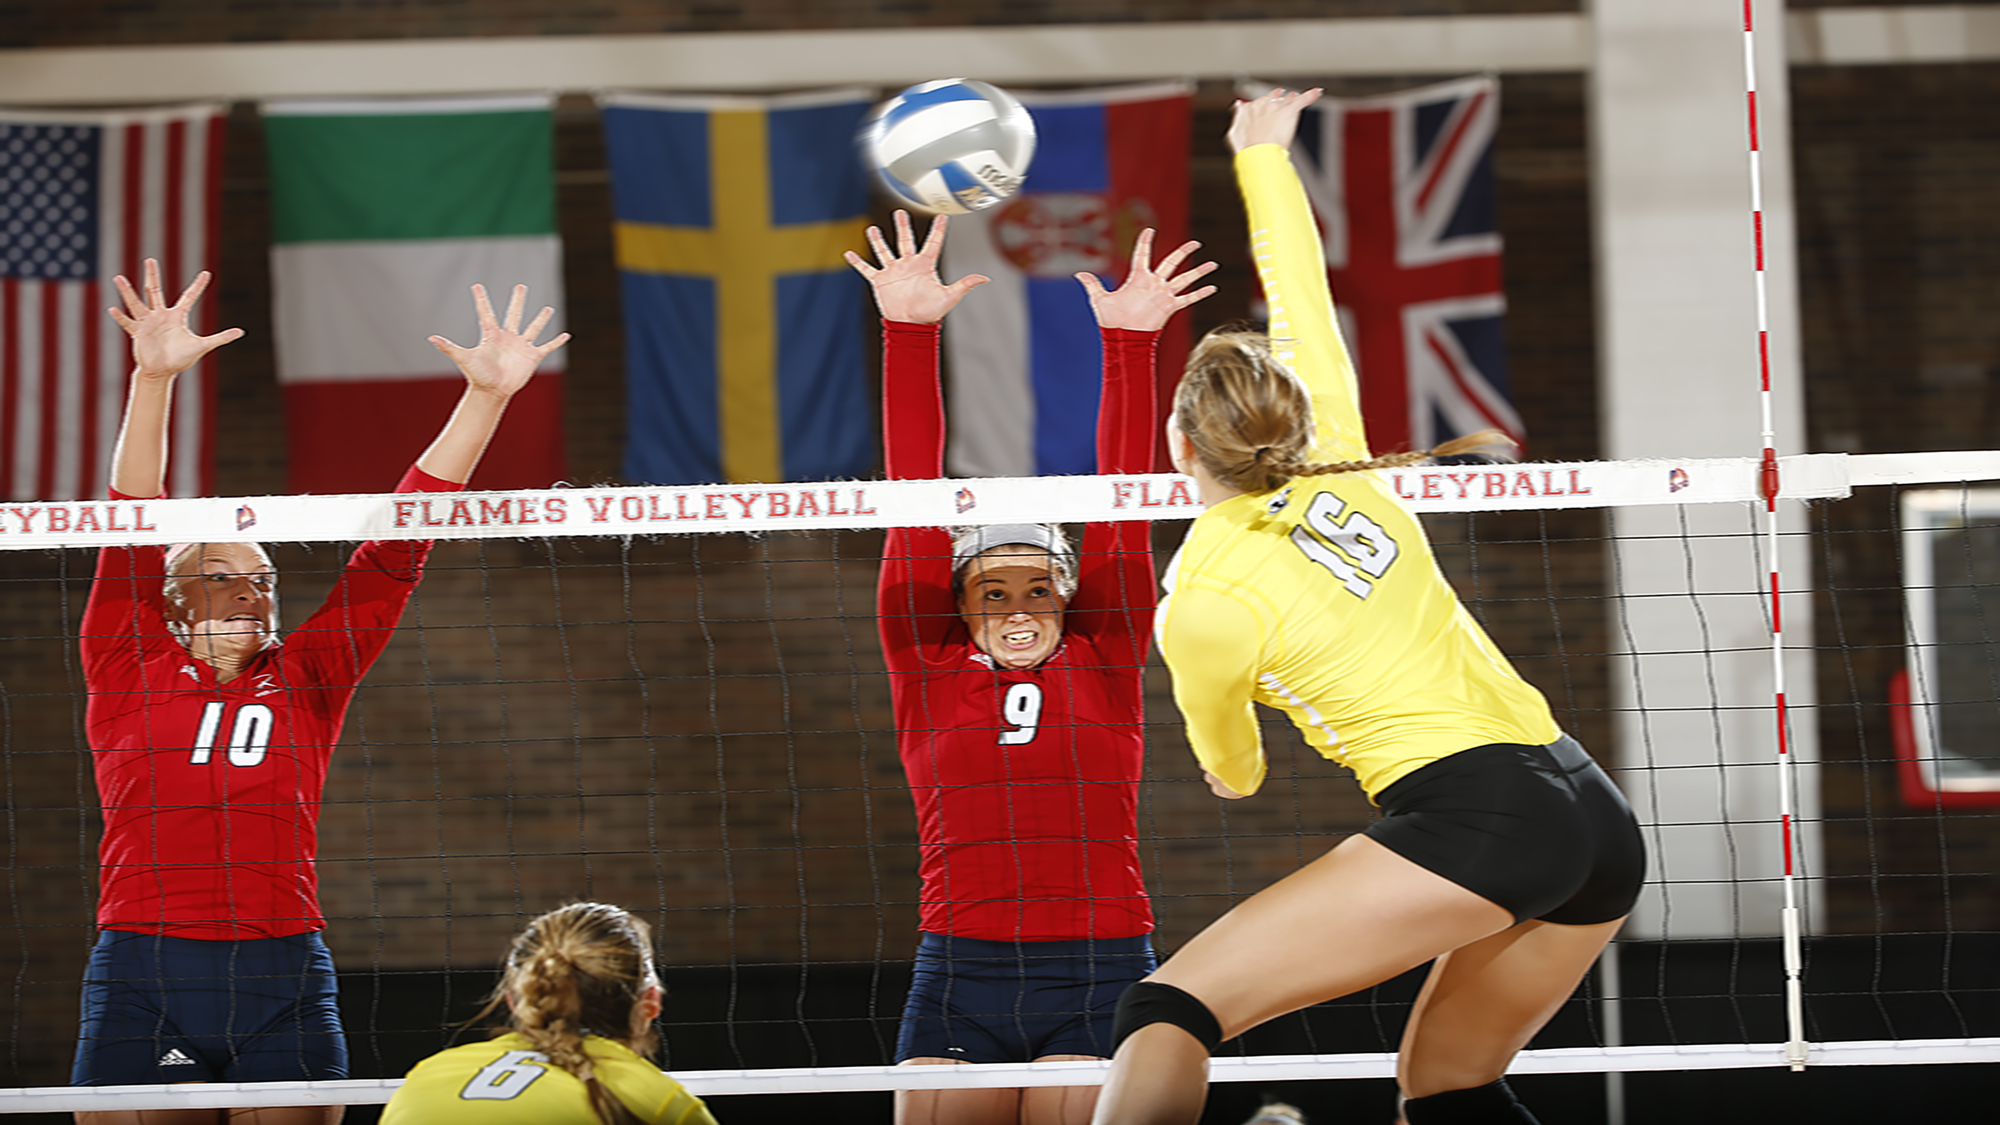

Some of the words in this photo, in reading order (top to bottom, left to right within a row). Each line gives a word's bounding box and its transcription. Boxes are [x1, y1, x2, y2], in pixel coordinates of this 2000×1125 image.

[392, 496, 568, 527] FLAMES
[584, 488, 877, 522] VOLLEYBALL
[1111, 480, 1204, 509] FLA
[1392, 467, 1592, 500] LEYBALL
[0, 504, 157, 533] YBALL
[1288, 490, 1400, 601] 16
[188, 700, 275, 768] 10
[996, 681, 1043, 746] 9
[457, 1049, 550, 1101] 6
